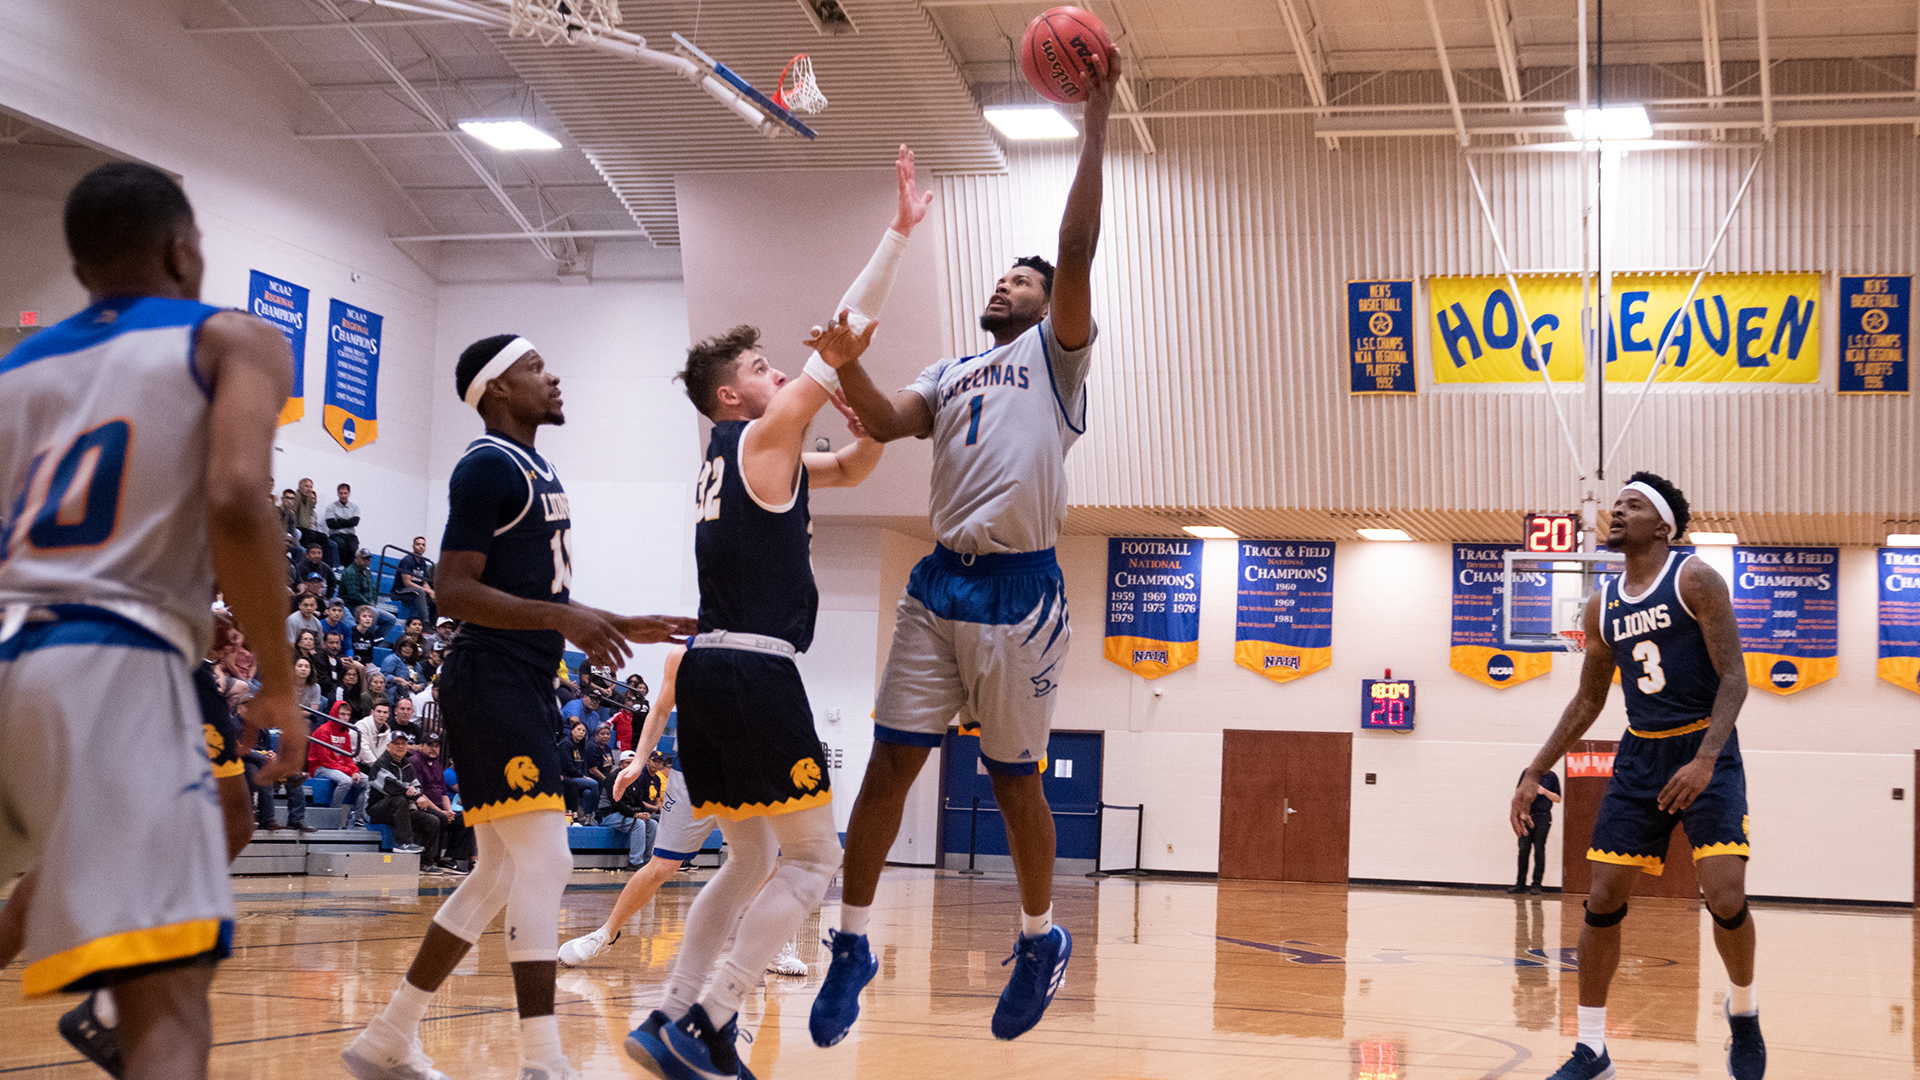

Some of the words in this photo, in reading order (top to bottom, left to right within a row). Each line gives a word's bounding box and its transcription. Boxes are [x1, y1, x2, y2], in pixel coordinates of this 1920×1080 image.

[1041, 38, 1080, 97] Wilson
[254, 297, 303, 330] CHAMPIONS
[1436, 288, 1560, 372] HOG
[331, 324, 378, 355] CHAMPIONS
[937, 364, 1030, 413] VELINAS
[964, 393, 986, 448] 1
[540, 492, 571, 522] LION
[1529, 517, 1573, 552] 20
[1121, 542, 1191, 556] FOOTBALL
[1242, 545, 1282, 557] TRACK
[1285, 545, 1295, 557] &
[1298, 545, 1331, 558] FIELD
[1457, 548, 1499, 560] TRACK
[1737, 551, 1781, 563] TRACK
[1783, 551, 1795, 564] &
[1797, 551, 1835, 564] FIELD
[1129, 558, 1182, 569] NATIONAL
[1115, 571, 1195, 590] CHAMPIONS
[1244, 565, 1327, 583] CHAMPIONS
[1460, 569, 1547, 586] CHAMIONS
[1739, 572, 1831, 591] CHAMPIONS
[1275, 583, 1297, 591] 1960
[1492, 587, 1512, 595] 19
[1111, 591, 1135, 601] 1959
[1143, 592, 1167, 602] 1969
[1173, 593, 1197, 602] 1970
[1274, 599, 1295, 607] 1969
[1111, 602, 1134, 612] 1974
[1142, 603, 1165, 612] 1975
[1173, 604, 1196, 613] 1976
[1110, 613, 1134, 623] 1979
[1274, 615, 1294, 623] 1981
[1612, 603, 1672, 642] LIONS
[1133, 650, 1168, 666] NAIA
[1263, 655, 1300, 672] NAIA
[1489, 666, 1514, 675] NCAA
[1631, 639, 1667, 695] 3
[1771, 673, 1799, 682] NCAA
[1371, 682, 1410, 699] 18:09
[1370, 698, 1404, 725] 20
